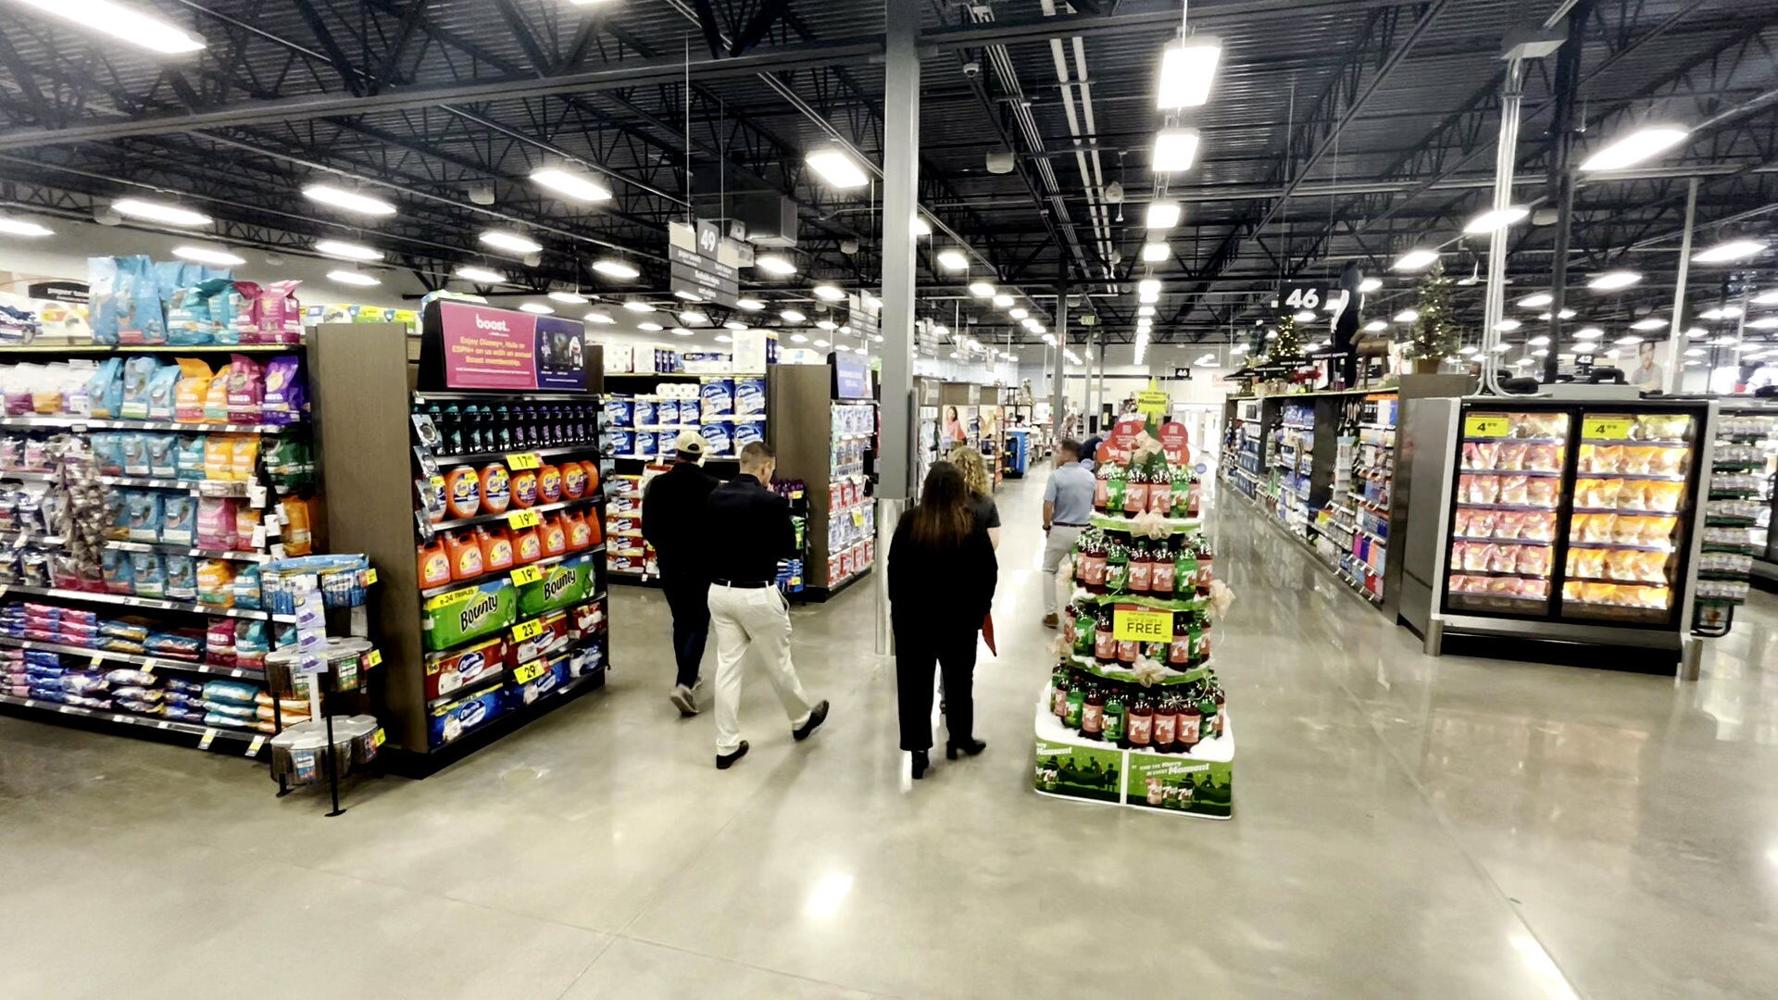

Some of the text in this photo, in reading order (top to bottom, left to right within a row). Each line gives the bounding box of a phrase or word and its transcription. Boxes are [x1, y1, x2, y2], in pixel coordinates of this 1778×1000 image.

[700, 229, 716, 252] 49
[1285, 288, 1319, 309] 46
[517, 456, 528, 467] 17
[518, 514, 530, 526] 19
[521, 569, 532, 582] 19
[544, 570, 576, 600] Bounty
[460, 594, 498, 632] Bounty
[522, 624, 534, 636] 23
[1127, 622, 1162, 634] FREE
[524, 664, 536, 678] 29
[1168, 762, 1210, 775] Moment
